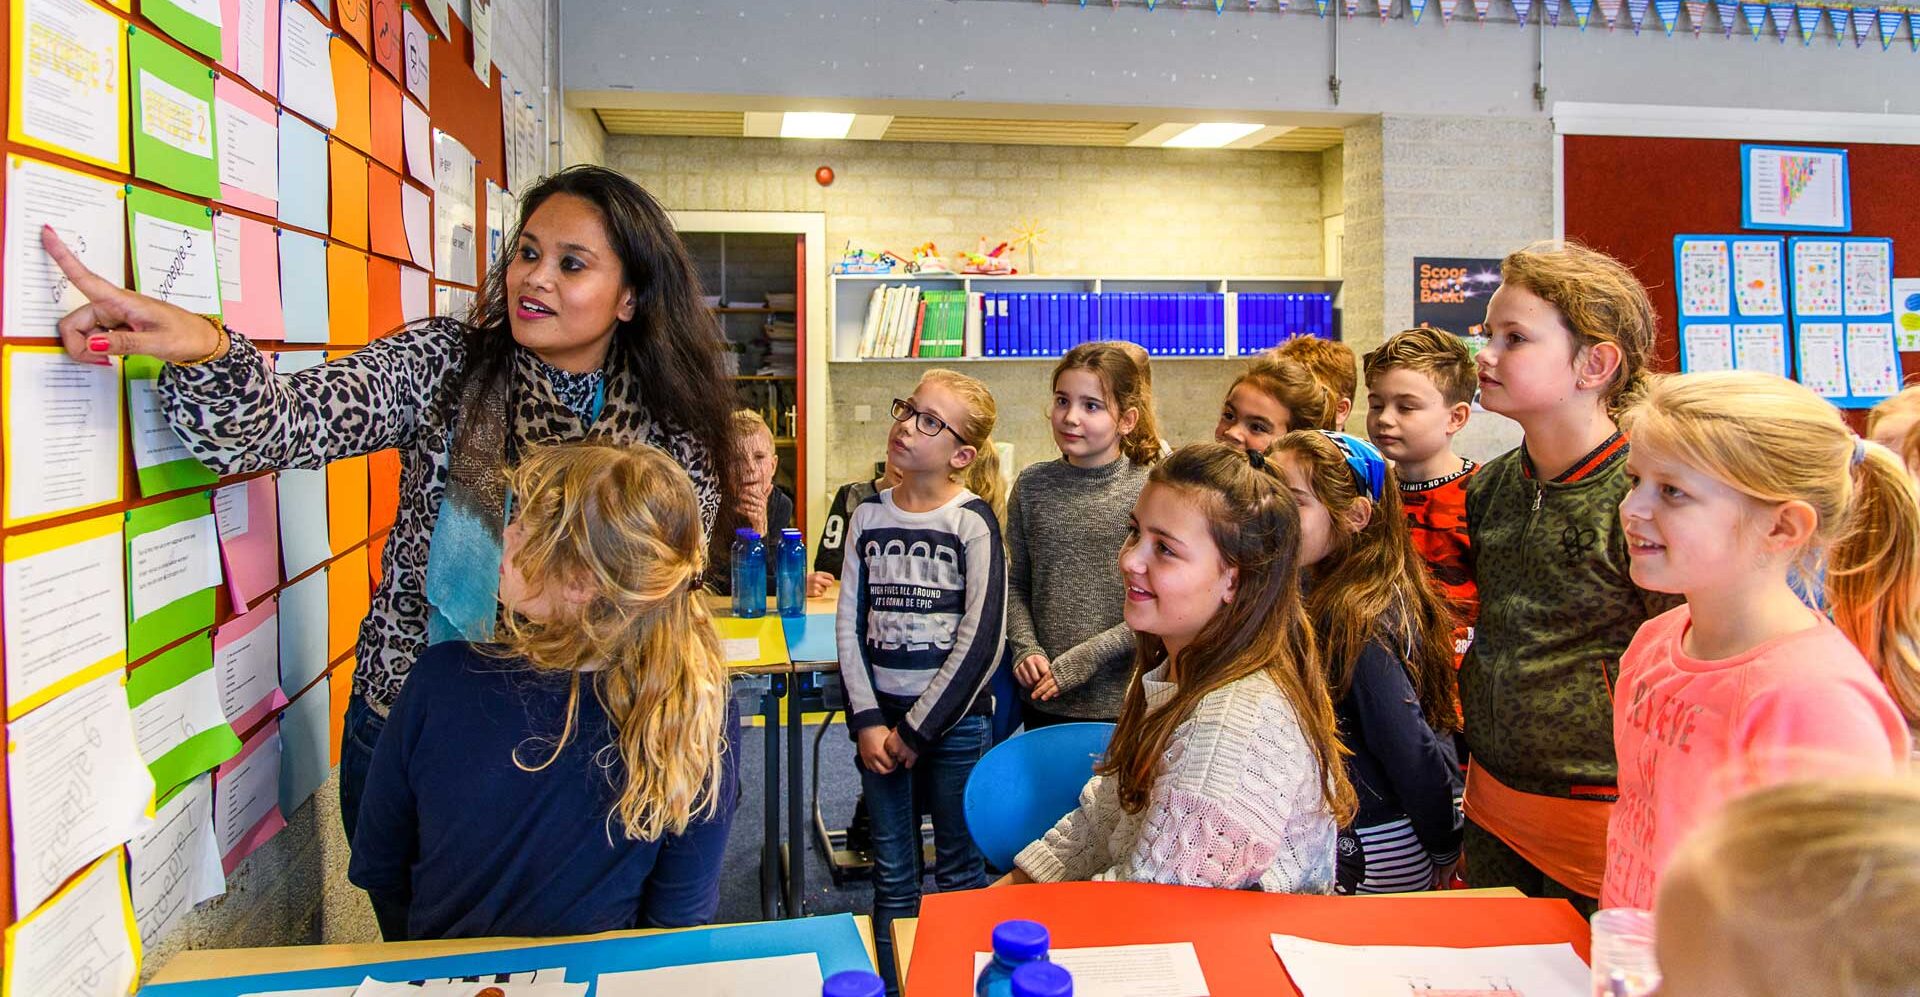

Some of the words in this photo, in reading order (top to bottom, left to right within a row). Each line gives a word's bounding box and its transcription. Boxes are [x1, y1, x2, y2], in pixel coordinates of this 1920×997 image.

[159, 246, 187, 303] Groepje
[182, 230, 193, 249] 3
[1428, 479, 1440, 489] NO
[823, 514, 845, 550] 9
[884, 586, 899, 596] FIVES
[900, 586, 911, 596] ALL
[911, 588, 942, 599] AROUND
[905, 598, 915, 608] BE
[916, 599, 933, 609] EPIC
